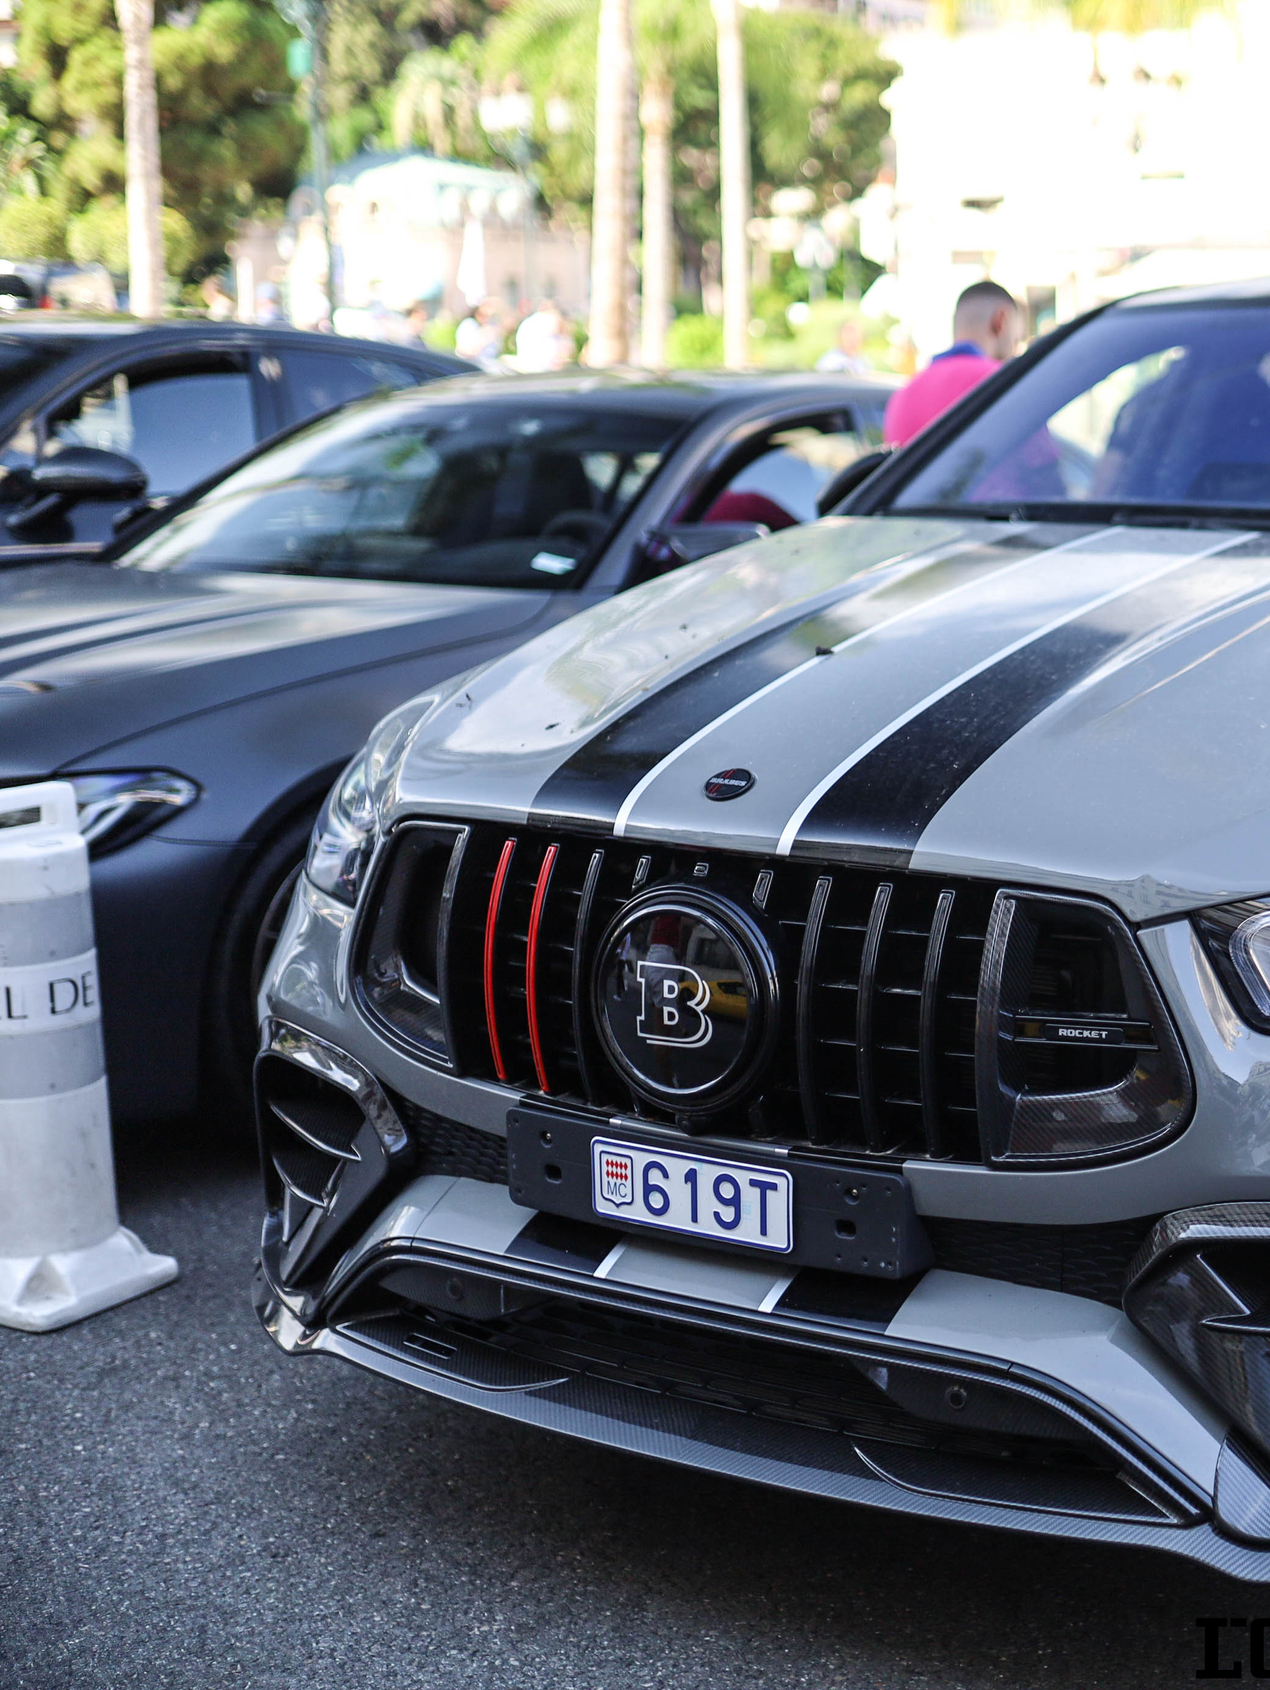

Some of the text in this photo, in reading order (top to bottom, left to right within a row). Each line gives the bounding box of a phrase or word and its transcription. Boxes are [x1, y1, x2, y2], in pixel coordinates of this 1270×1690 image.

[0, 970, 95, 1019] L DE
[1058, 1028, 1108, 1039] ROCKET
[607, 1160, 778, 1236] MC 619T
